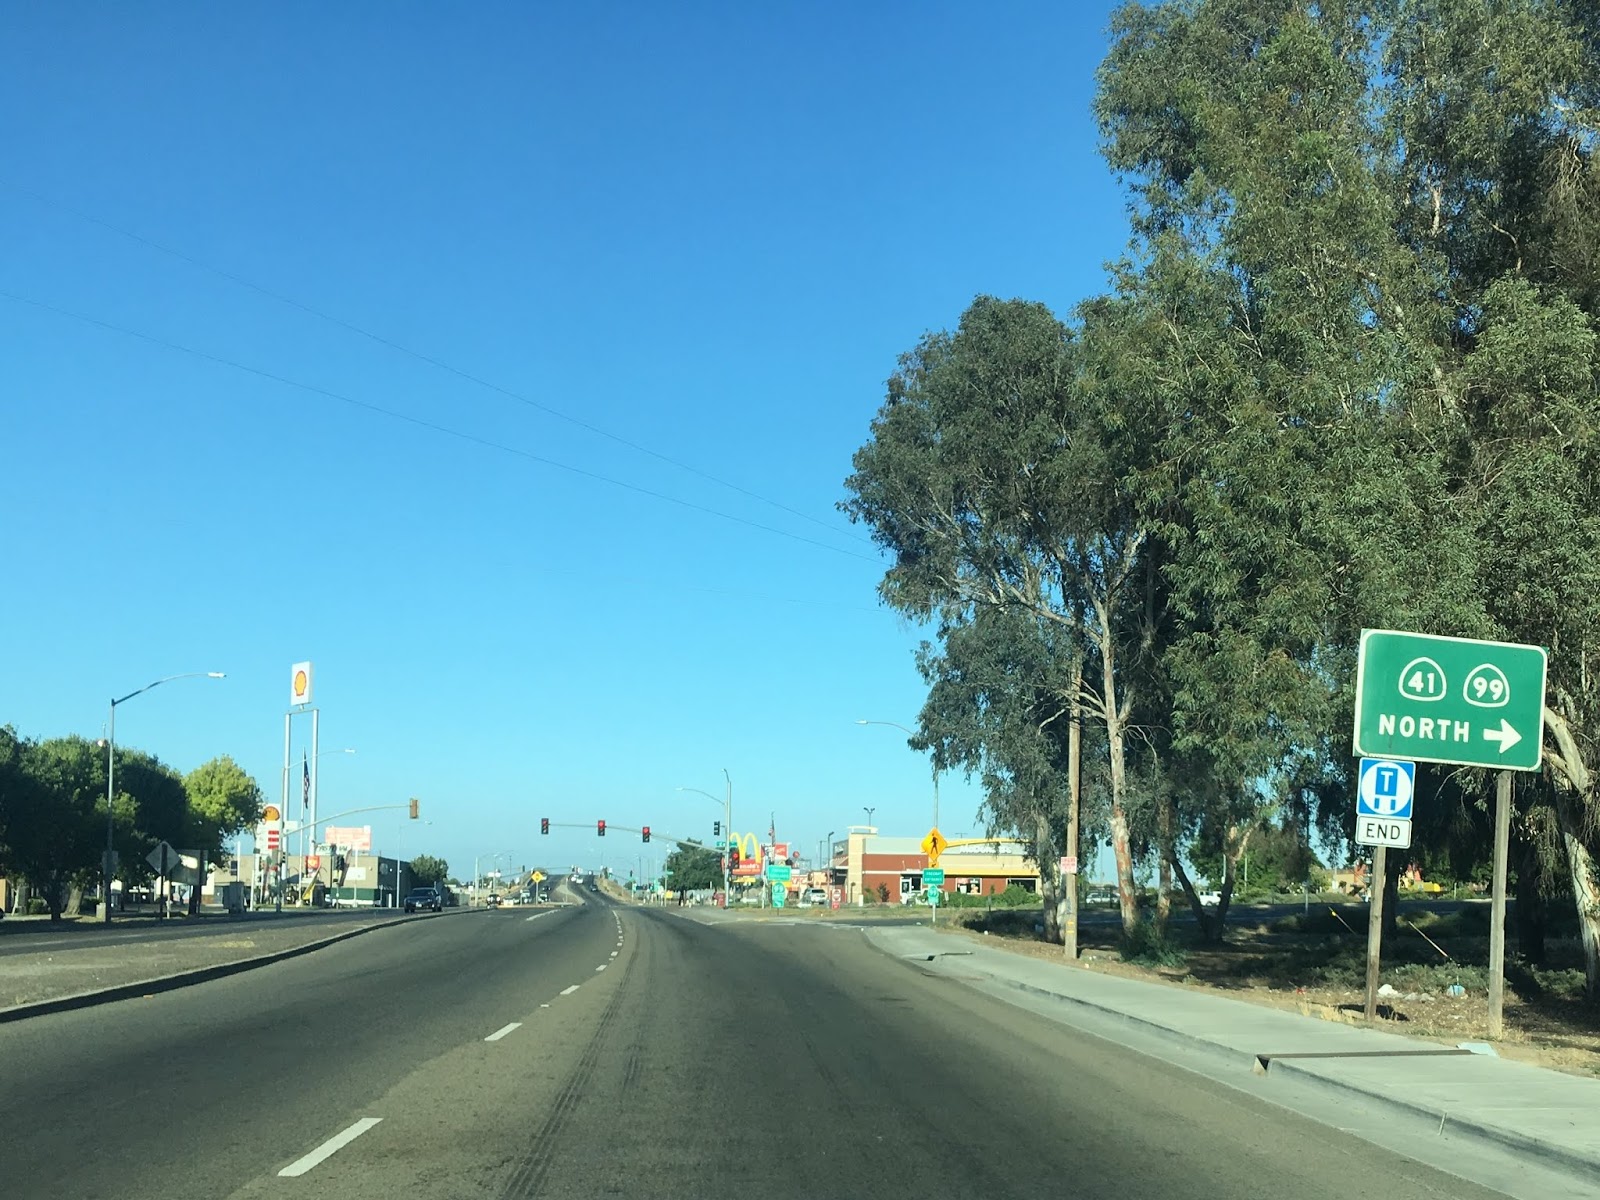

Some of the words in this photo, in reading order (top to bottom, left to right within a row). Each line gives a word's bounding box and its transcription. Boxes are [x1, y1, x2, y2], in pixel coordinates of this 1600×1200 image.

[1408, 671, 1435, 694] 41
[1473, 677, 1504, 701] 99
[1378, 714, 1470, 743] NORTH
[1365, 823, 1401, 840] END
